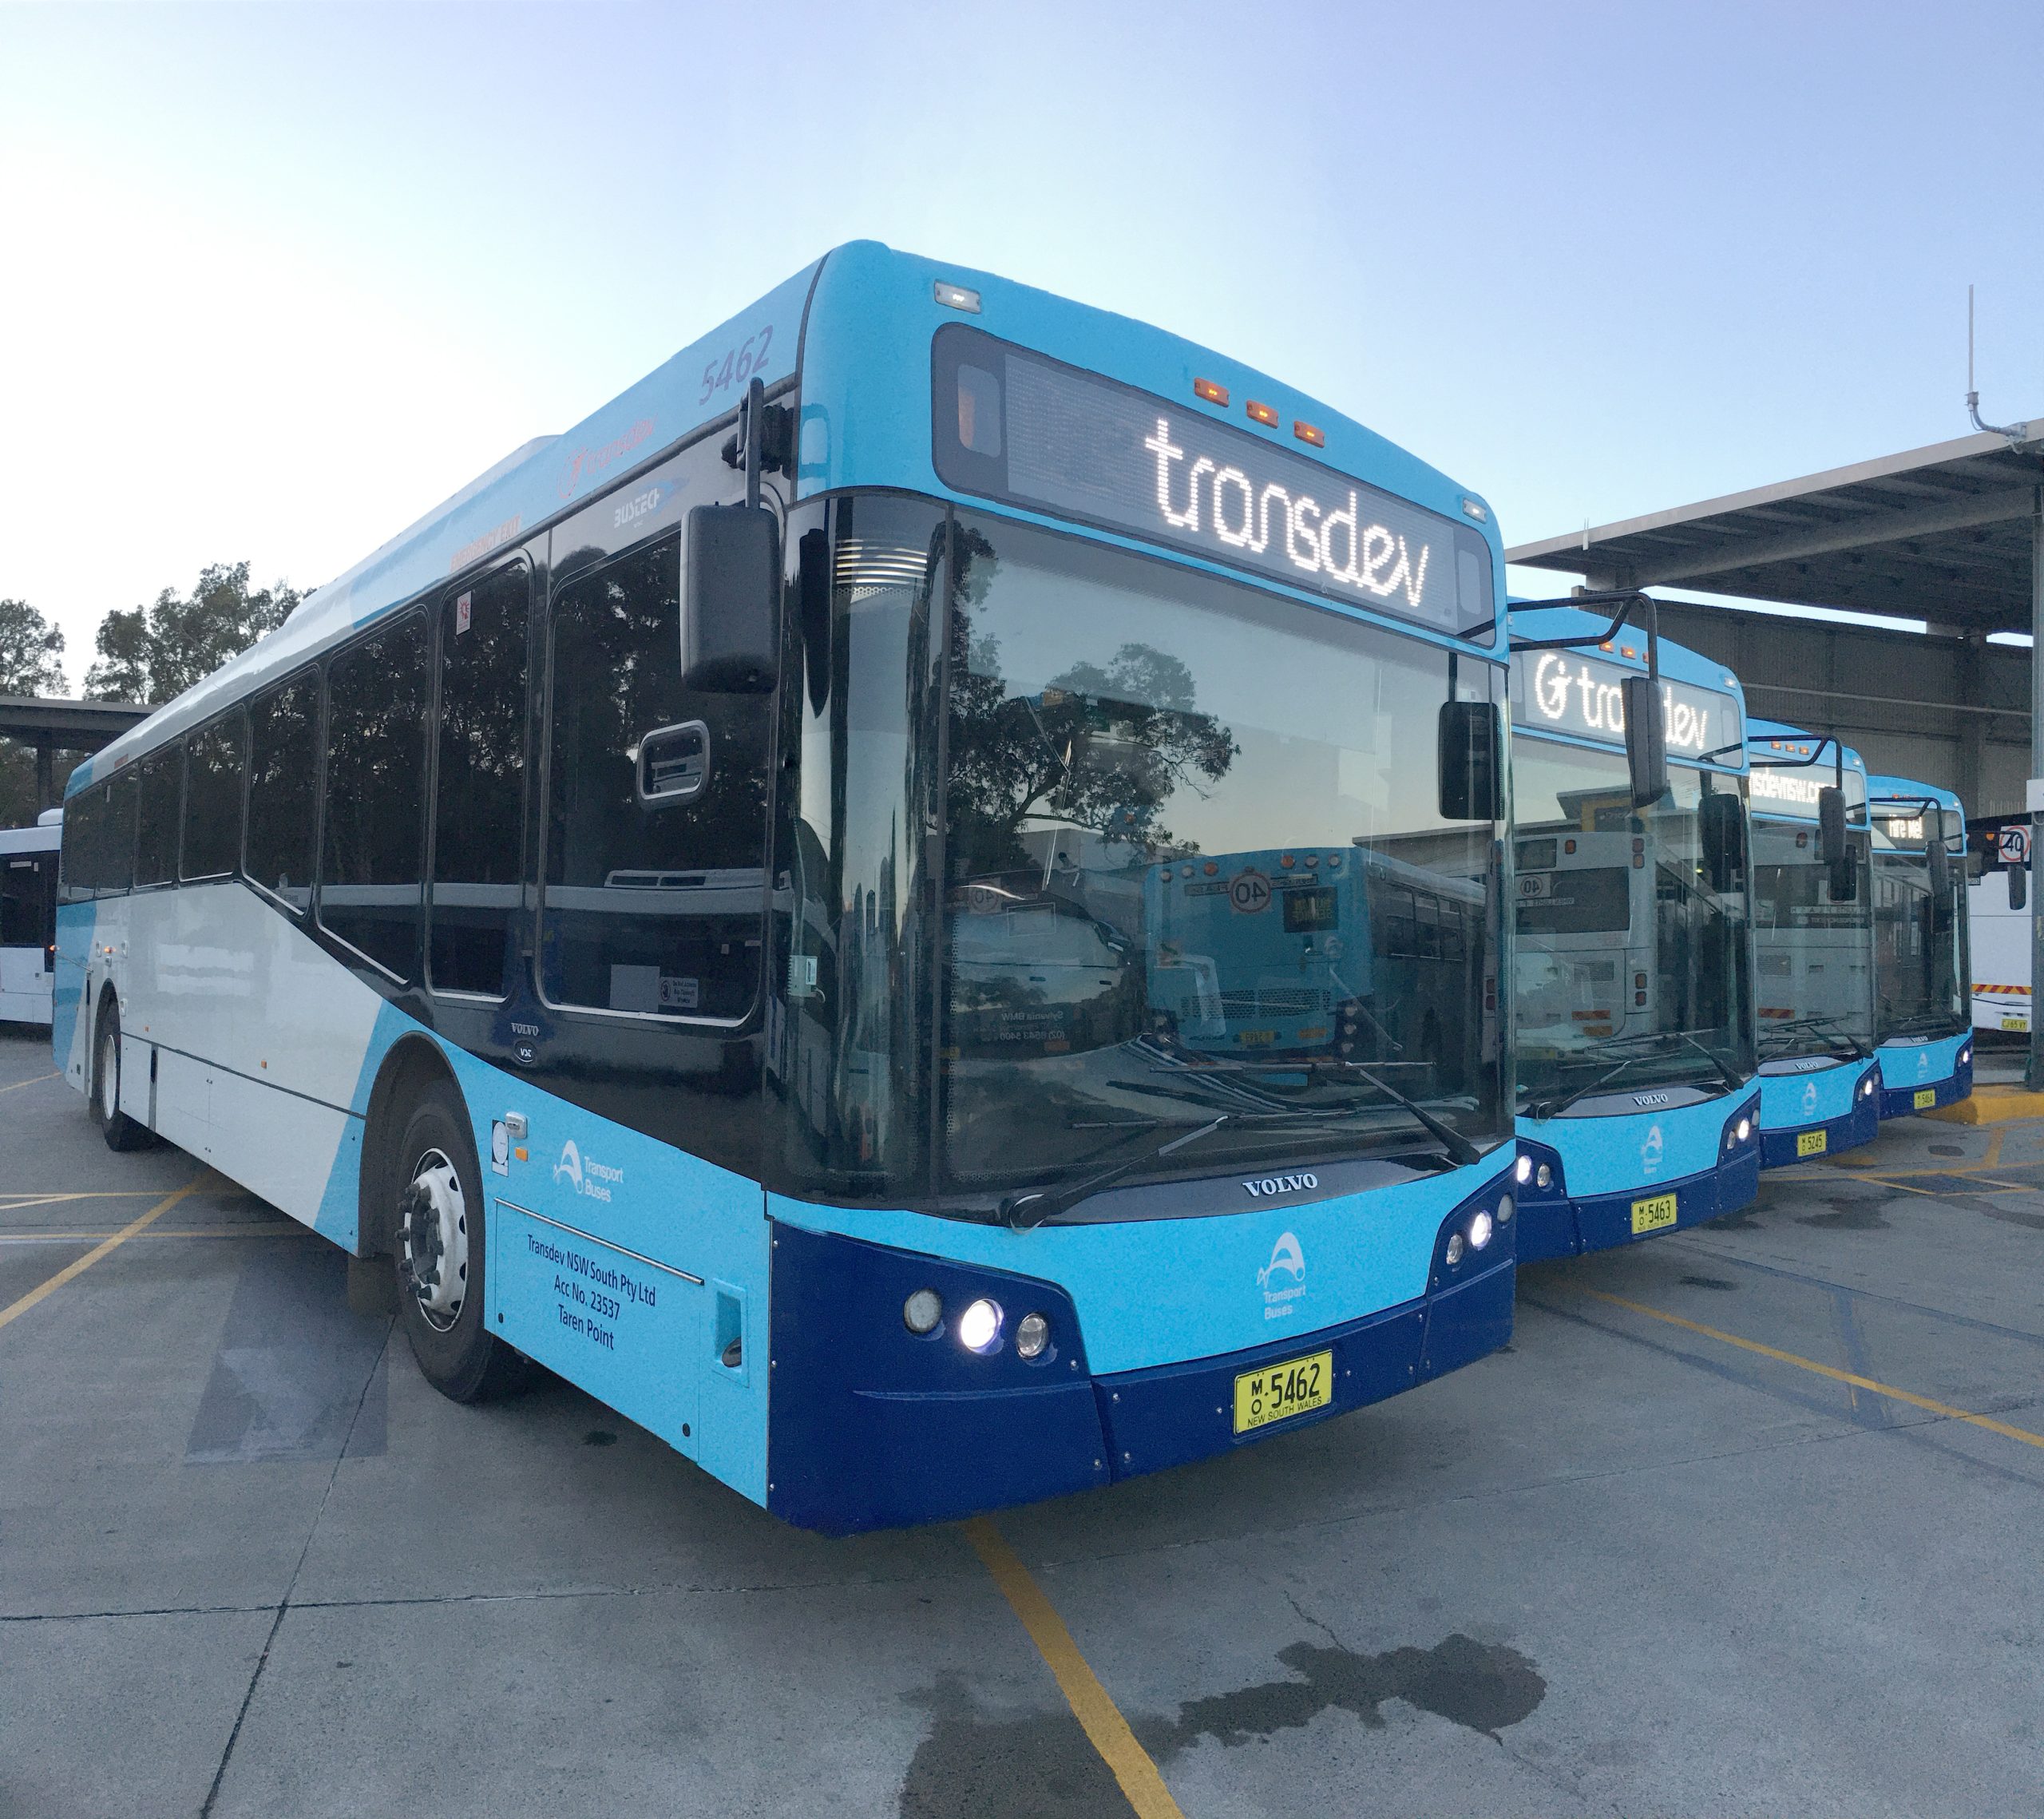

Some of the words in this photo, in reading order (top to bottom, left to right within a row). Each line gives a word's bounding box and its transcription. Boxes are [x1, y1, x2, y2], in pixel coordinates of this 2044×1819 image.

[699, 324, 773, 406] 5462
[1146, 419, 1429, 607] transdev
[511, 1023, 539, 1036] VOLVO
[1633, 1094, 1669, 1106] VOLVO
[584, 1155, 624, 1184] Transport
[584, 1179, 612, 1203] Buses
[1242, 1173, 1318, 1198] VOLVO
[1648, 1199, 1671, 1223] 5463
[527, 1234, 565, 1266] Transdev
[567, 1250, 589, 1277] NSW
[590, 1261, 618, 1290] South
[620, 1271, 637, 1303] Pty
[639, 1283, 656, 1307] Ltd
[554, 1274, 570, 1298] Acc
[572, 1283, 588, 1306] No.
[590, 1290, 620, 1320] 23537
[1264, 1284, 1306, 1304] Transport
[558, 1303, 584, 1334] Taren
[587, 1322, 614, 1351] Point
[1265, 1305, 1293, 1320] Buses
[1271, 1362, 1321, 1409] 5462
[1247, 1412, 1266, 1429] NEW
[1268, 1405, 1295, 1422] SOUTH
[1297, 1395, 1323, 1413] WALES
